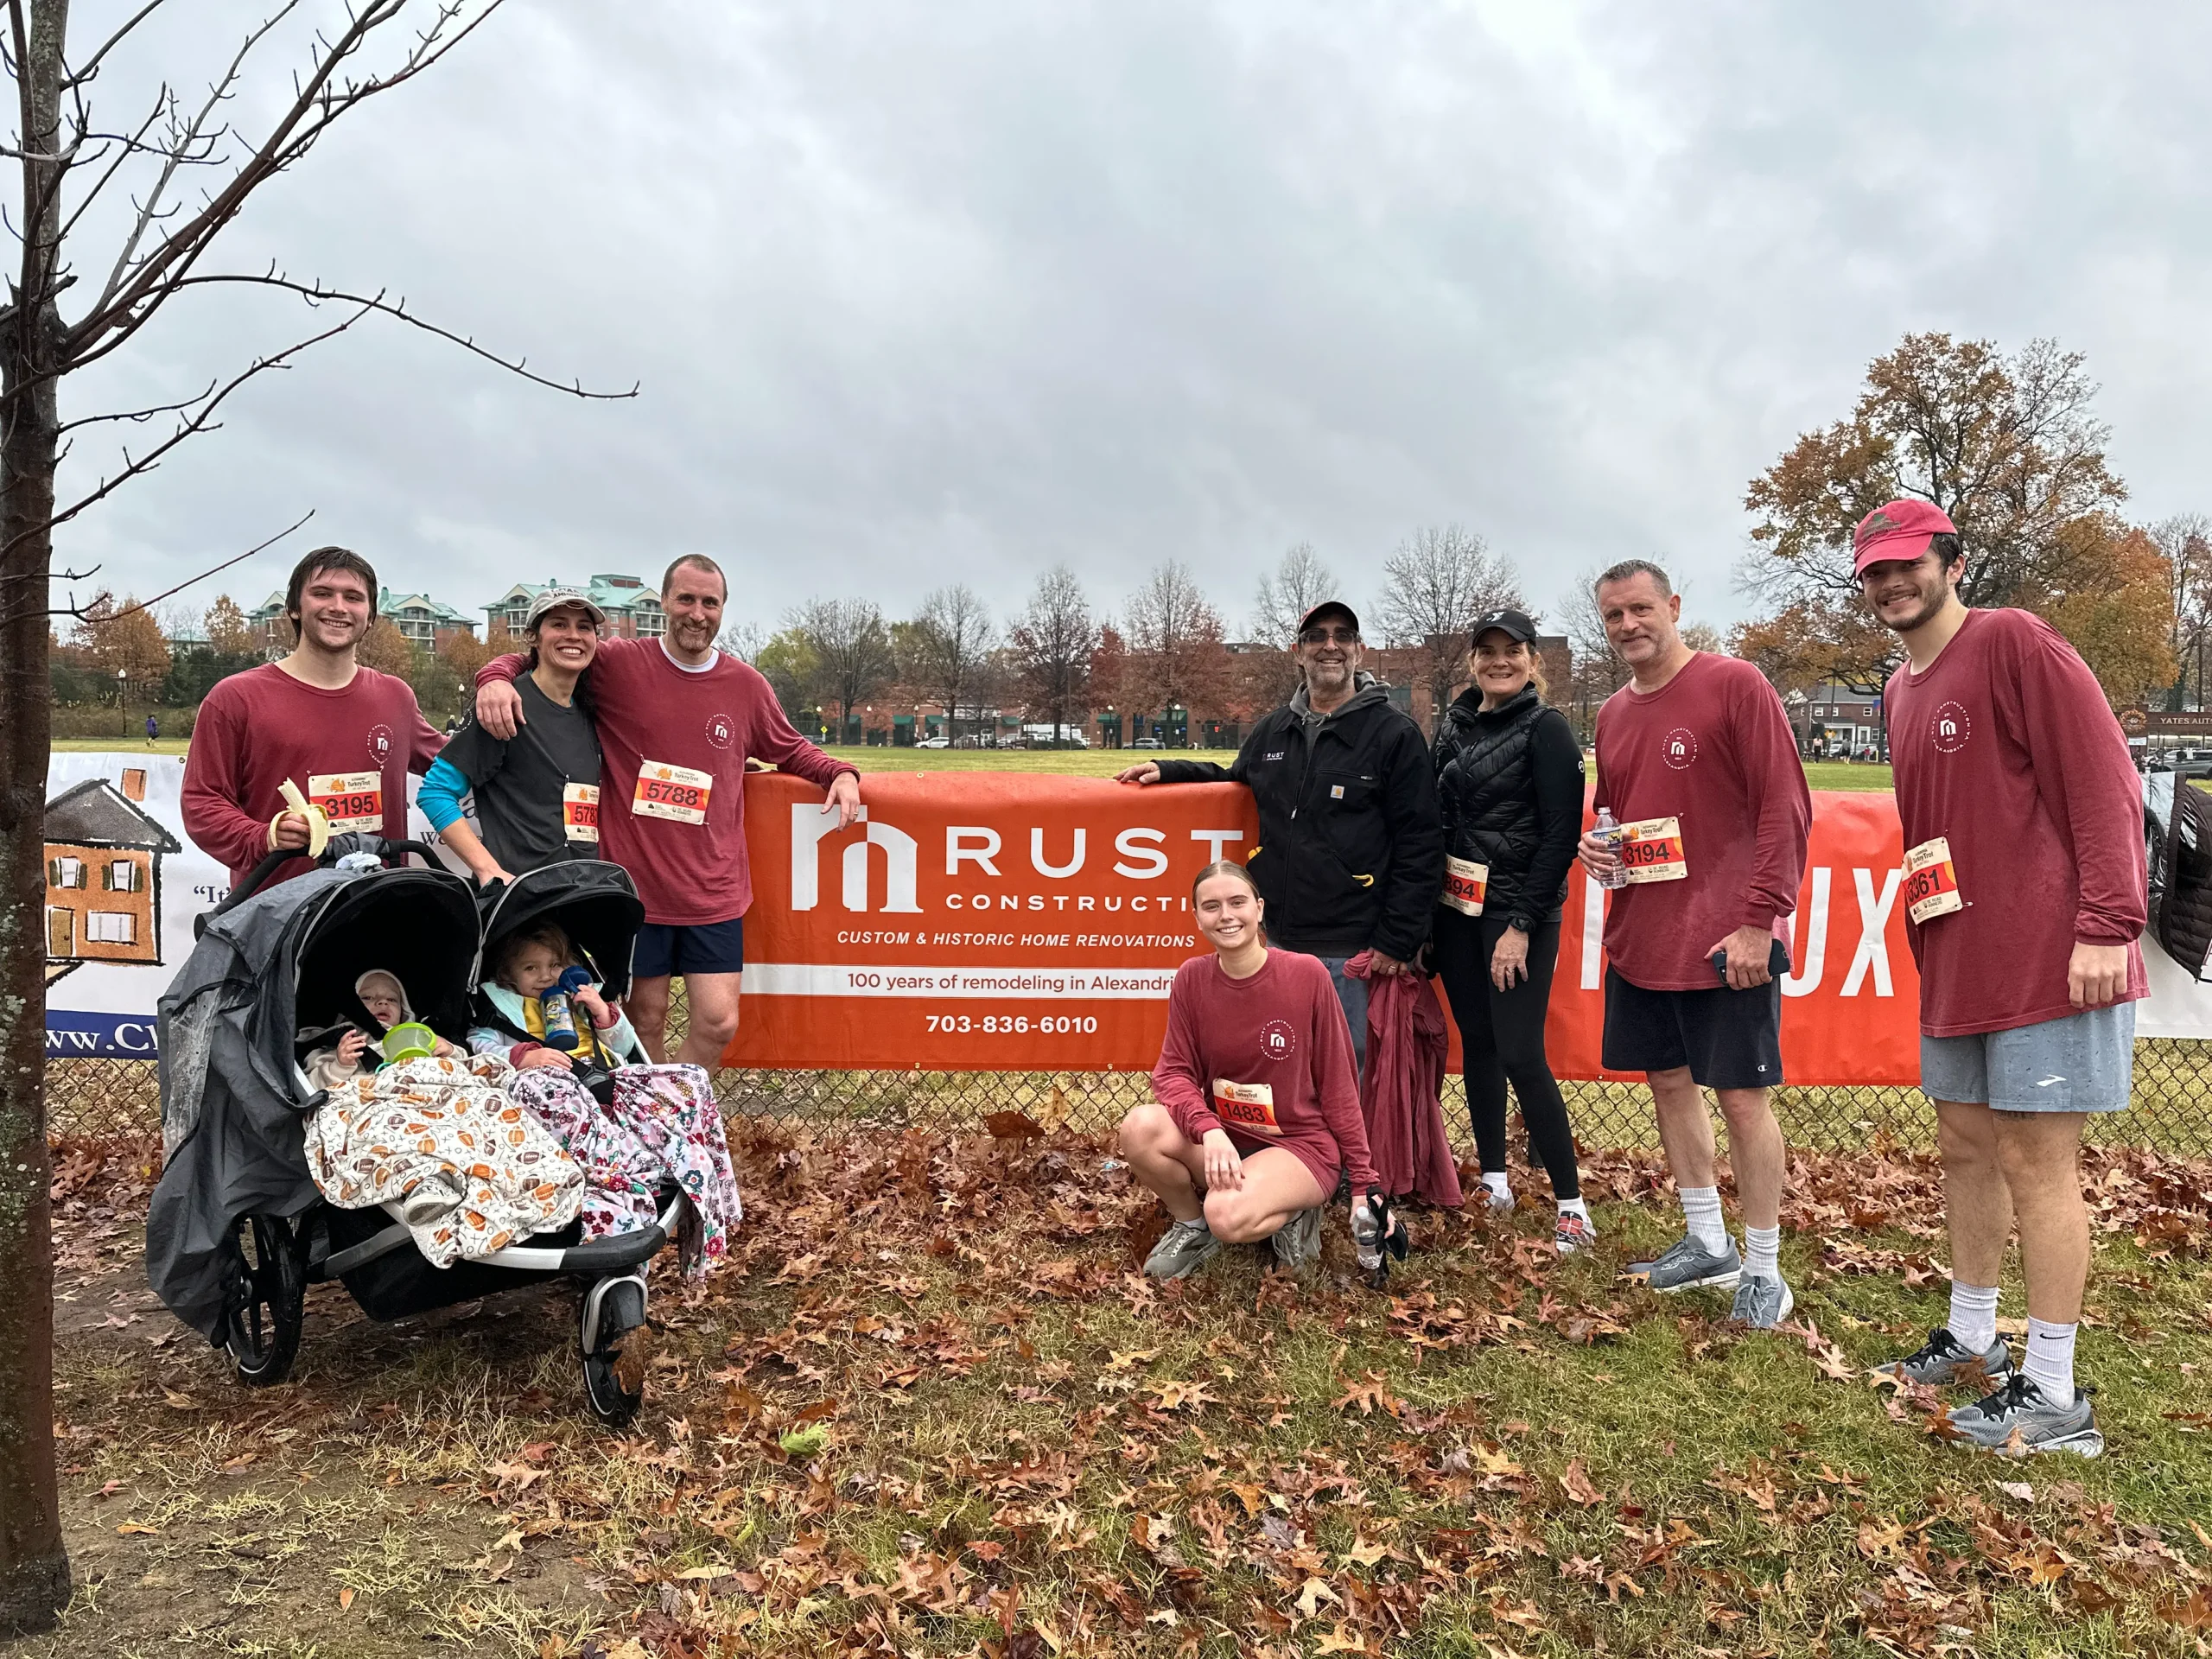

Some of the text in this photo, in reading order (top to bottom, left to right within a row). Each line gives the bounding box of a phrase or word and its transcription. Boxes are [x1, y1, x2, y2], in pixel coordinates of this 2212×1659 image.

[647, 782, 698, 805] 5788
[325, 795, 374, 817] 3195
[946, 826, 1243, 880] RUST
[1625, 842, 1669, 865] 3194
[1908, 868, 1940, 902] 3361
[945, 893, 1187, 912] CONSTRUCTI
[837, 931, 1195, 948] CUSTOM & HISTORIC HOME RENOVATIONS
[848, 973, 1174, 992] 100 years of remodeling in Alexandri
[925, 1015, 1097, 1033] 703-836-6010
[1224, 1103, 1266, 1122] 1483
